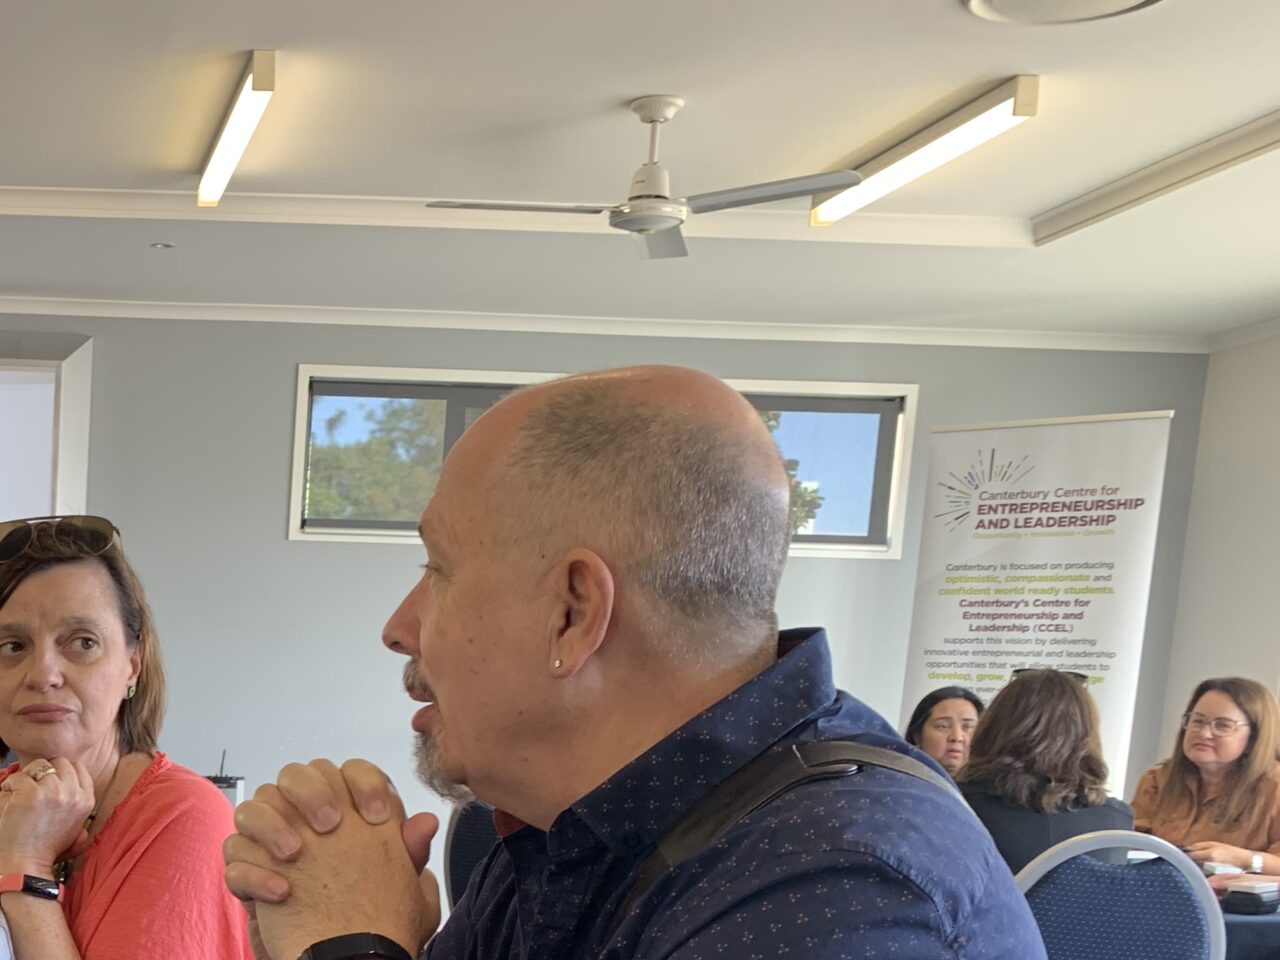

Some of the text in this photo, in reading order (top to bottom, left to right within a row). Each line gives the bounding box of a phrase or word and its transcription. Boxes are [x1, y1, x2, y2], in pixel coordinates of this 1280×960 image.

[978, 485, 1120, 501] Canterbury Centre for
[977, 498, 1145, 515] ENTREPRENEURSHIP
[975, 514, 1117, 530] AND LEADERSHIP
[946, 561, 1114, 573] Canterbury is focused on producing
[1004, 574, 1091, 584] compassionate
[1093, 574, 1112, 582] and
[939, 586, 991, 595] confident
[993, 586, 1025, 595] world
[1028, 586, 1061, 596] ready
[959, 598, 1091, 609] Canterbury's Centre for
[962, 611, 1084, 621] Entrepreneurship and
[969, 624, 1074, 634] Leadership (CCEL)
[944, 636, 1097, 646] supports this vision by delivering
[924, 649, 1116, 660] innovative entrepreneurial and leadership
[926, 660, 986, 670] opportunities
[989, 661, 1007, 669] that
[1010, 661, 1027, 669] will
[1056, 662, 1097, 671] students
[1099, 663, 1110, 671] to
[928, 671, 974, 682] develop,
